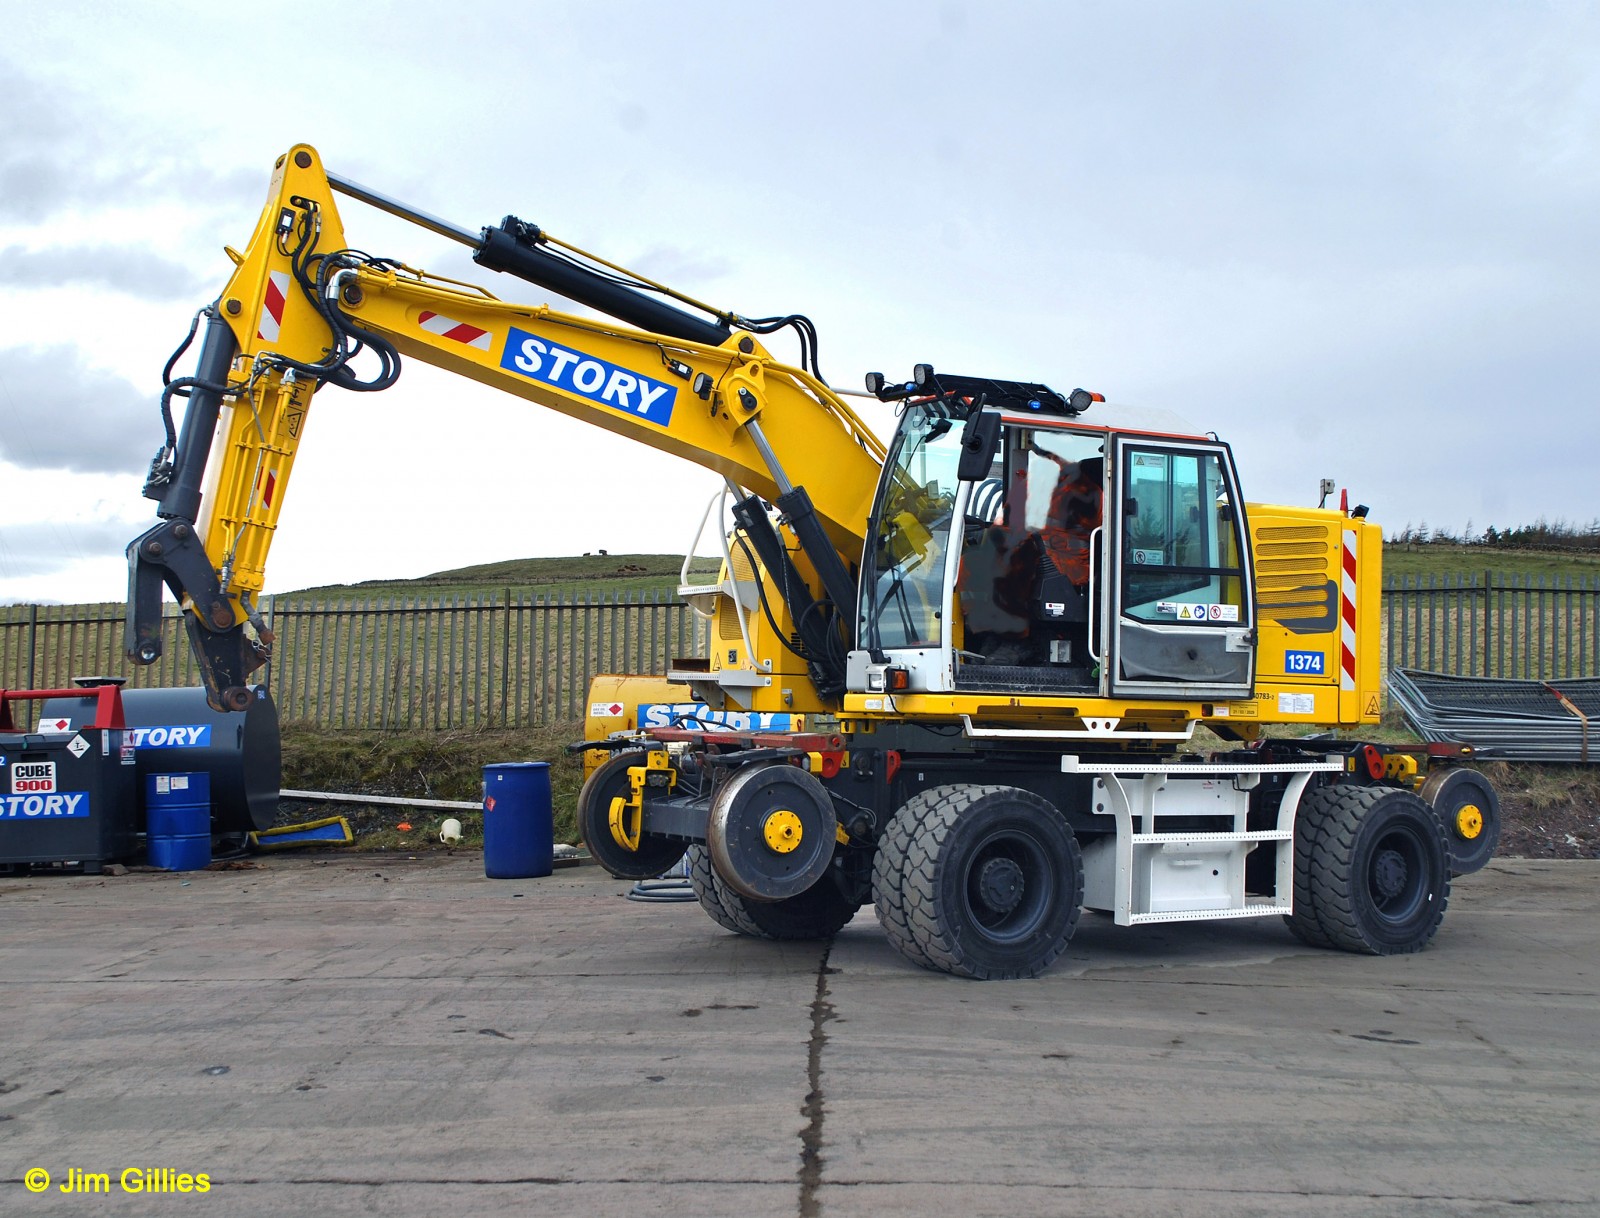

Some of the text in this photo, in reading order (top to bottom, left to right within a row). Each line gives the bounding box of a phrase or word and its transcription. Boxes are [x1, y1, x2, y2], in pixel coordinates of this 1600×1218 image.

[514, 338, 669, 414] STORY
[1288, 654, 1321, 671] 1374
[1254, 692, 1275, 701] 0783-2
[134, 726, 207, 747] TORY
[15, 764, 53, 778] CUBE
[15, 779, 53, 792] 900
